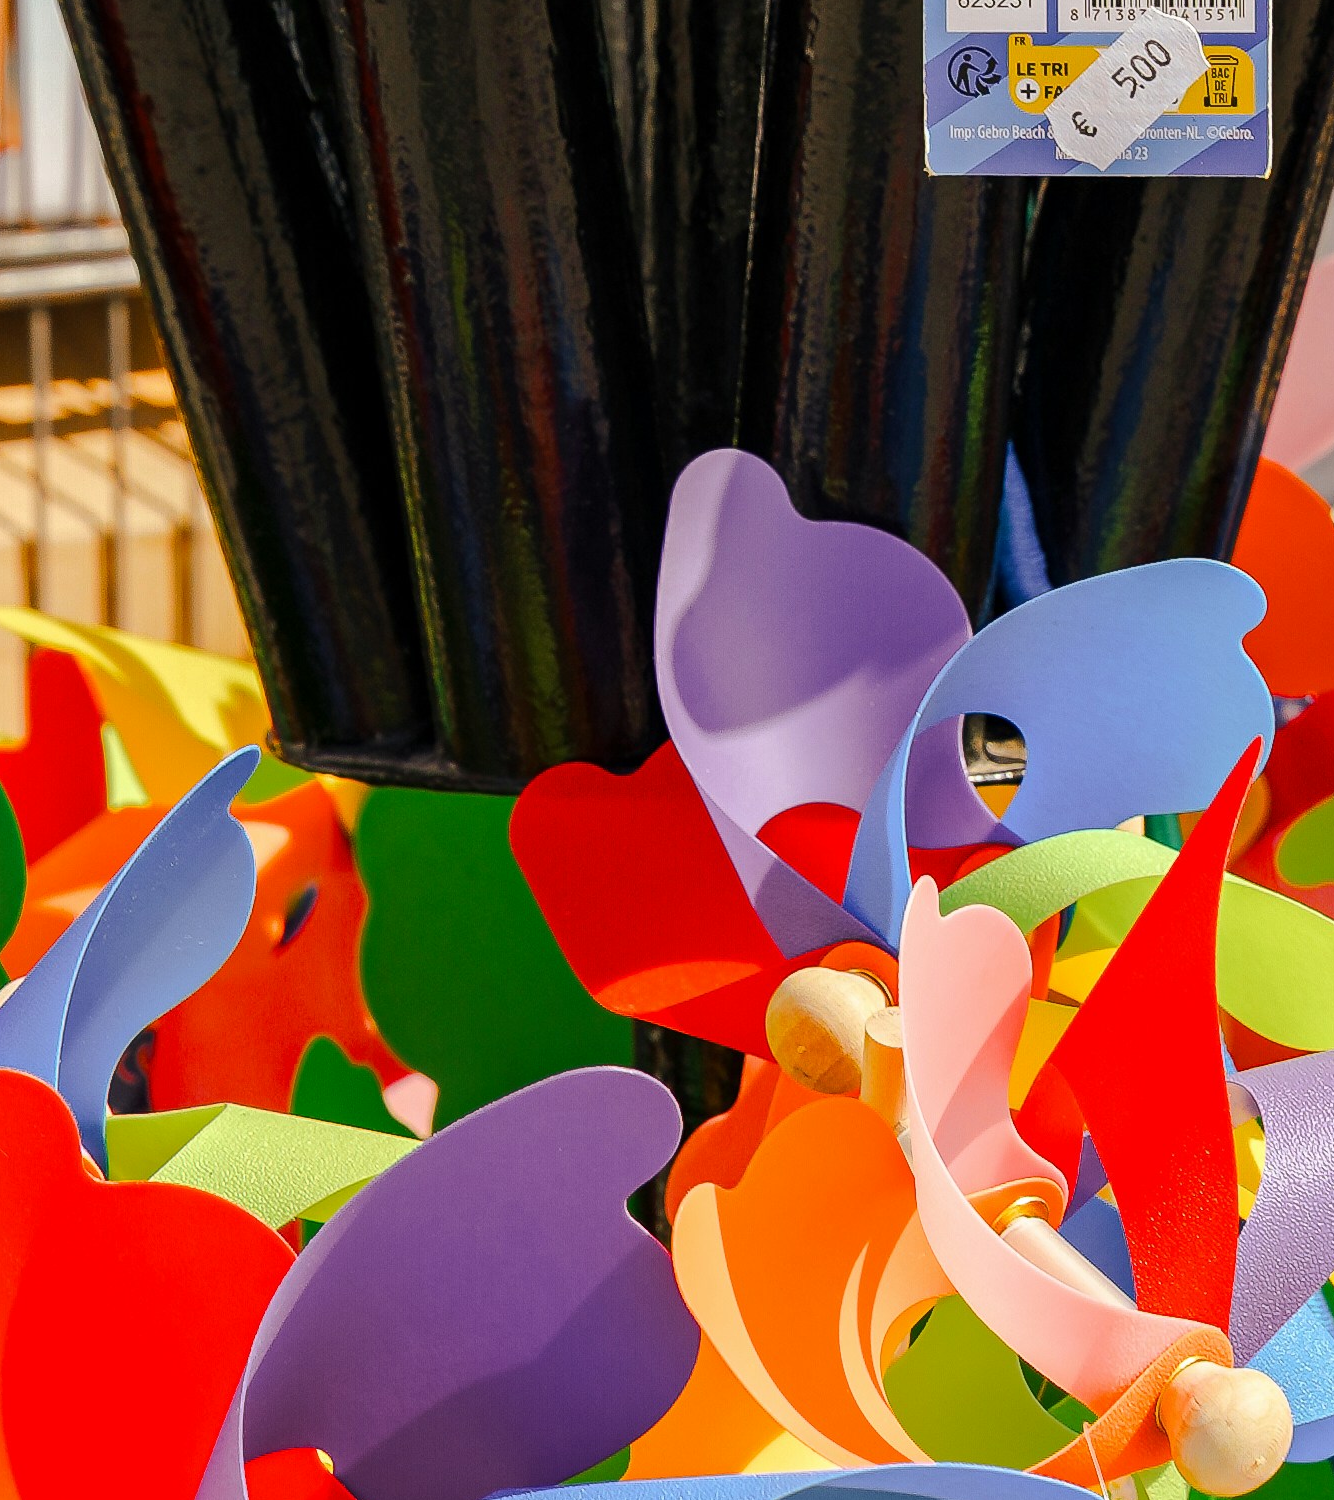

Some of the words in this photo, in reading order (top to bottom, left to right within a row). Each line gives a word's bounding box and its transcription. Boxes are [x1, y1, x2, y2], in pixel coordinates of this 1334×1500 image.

[1093, 9, 1147, 21] 7138
[1014, 37, 1026, 46] FR
[1017, 63, 1036, 76] LE
[1040, 63, 1068, 76] TRI
[1211, 67, 1230, 79] BAC
[1215, 81, 1227, 92] DE
[1213, 93, 1228, 104] TRI
[1071, 111, 1098, 138] €
[949, 125, 976, 141] Imp:
[978, 124, 1011, 140] Gebro
[1013, 124, 1045, 140] Beach
[1134, 147, 1148, 160] 23
